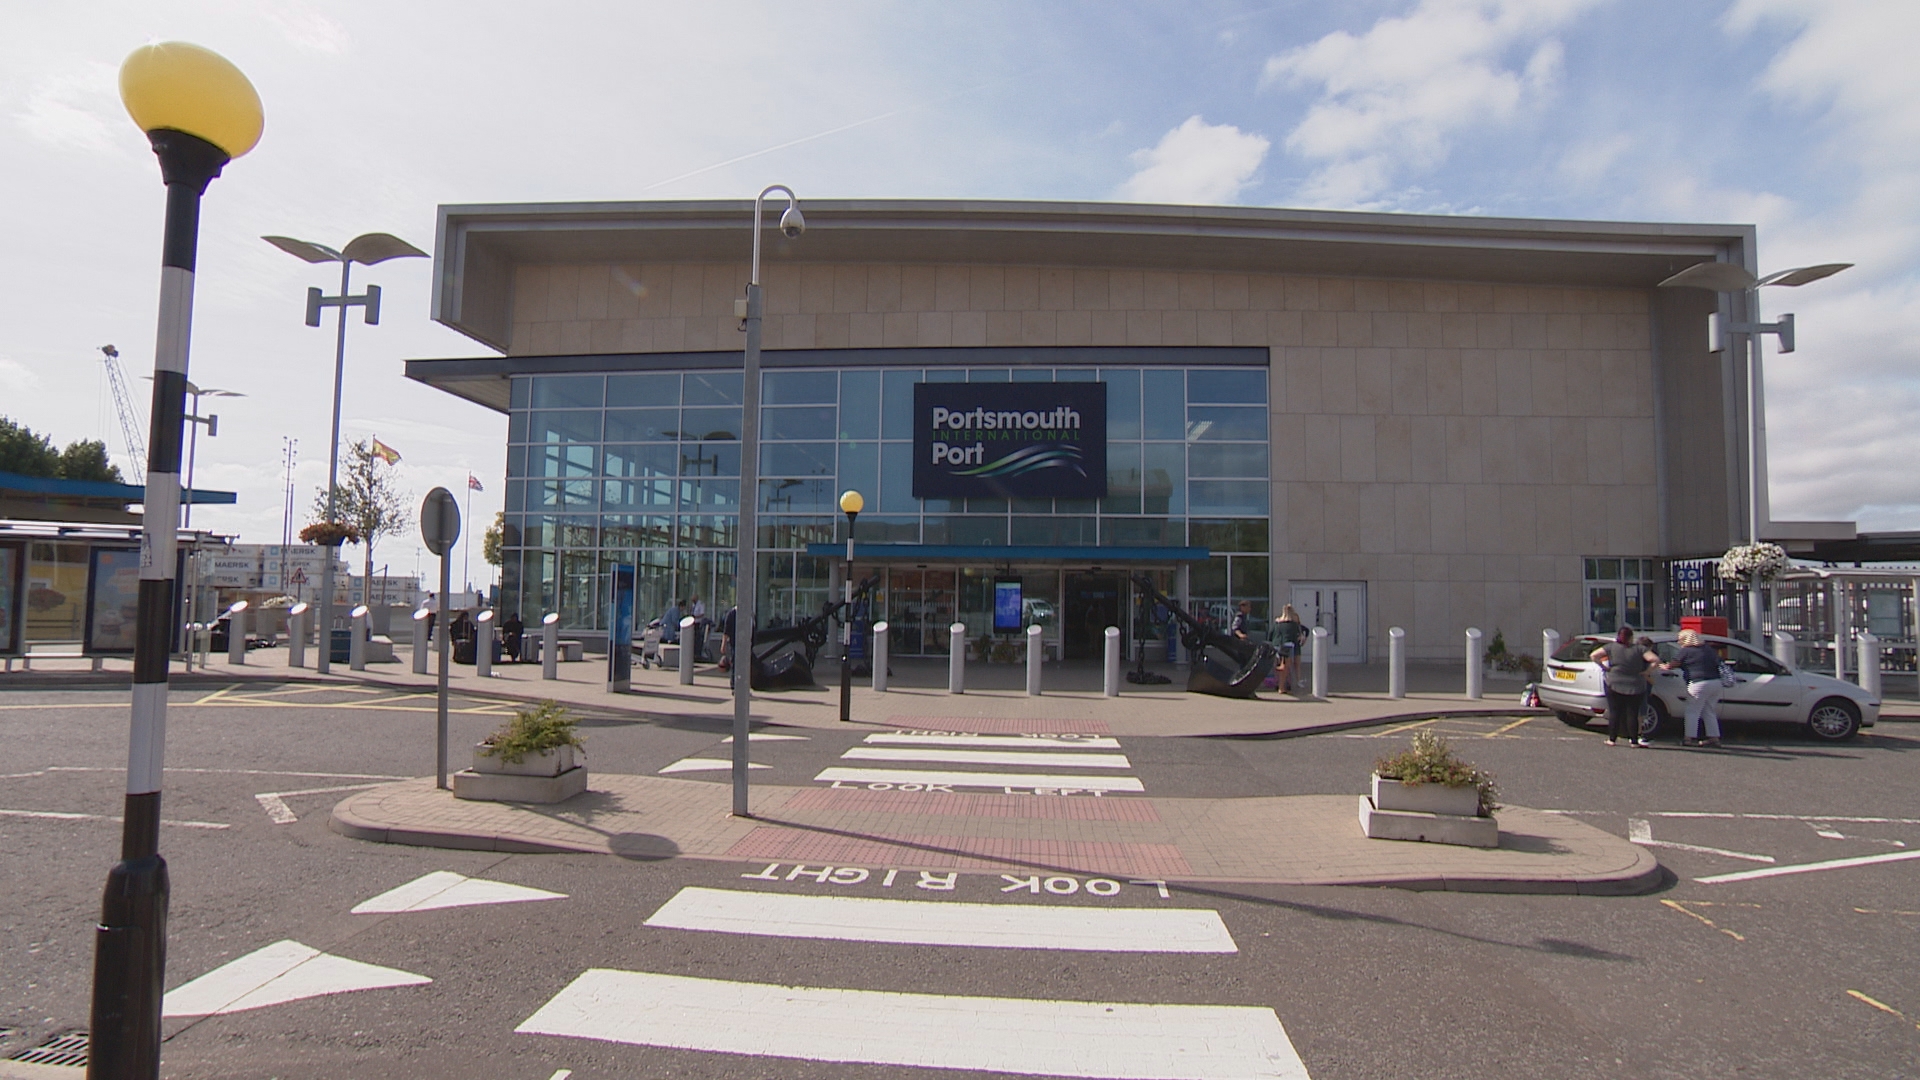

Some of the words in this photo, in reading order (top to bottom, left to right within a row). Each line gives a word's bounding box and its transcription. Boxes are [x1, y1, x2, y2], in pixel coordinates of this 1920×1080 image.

[932, 406, 1081, 430] Portsmouth
[932, 430, 1080, 441] INTERNATIONAL
[932, 442, 985, 465] Port
[215, 561, 250, 569] MAERSK
[831, 781, 954, 793] LOOK
[1004, 786, 1107, 798] LEFT
[741, 862, 958, 891] RIGHT
[1000, 873, 1172, 898] LOOK
